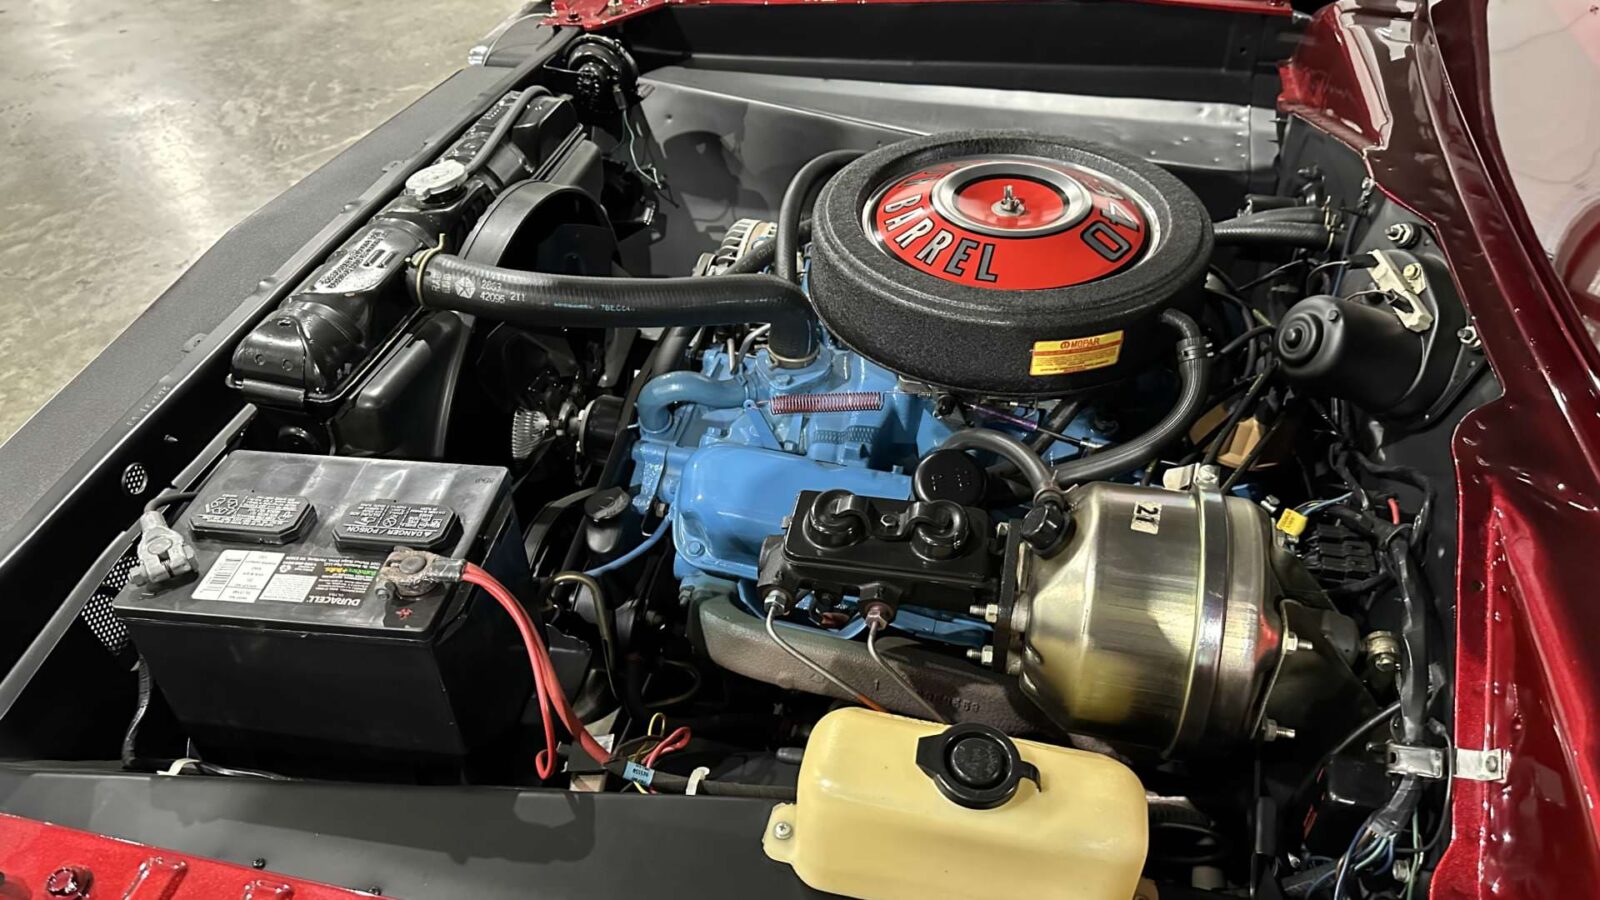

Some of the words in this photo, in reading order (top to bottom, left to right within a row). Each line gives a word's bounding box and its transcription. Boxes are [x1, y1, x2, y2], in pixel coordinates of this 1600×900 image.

[884, 194, 998, 282] BARREL
[1070, 337, 1100, 348] MOPAR
[1136, 504, 1159, 525] 21
[347, 526, 377, 534] POISON
[387, 529, 424, 537] DANGER
[308, 595, 360, 606] DURACELL
